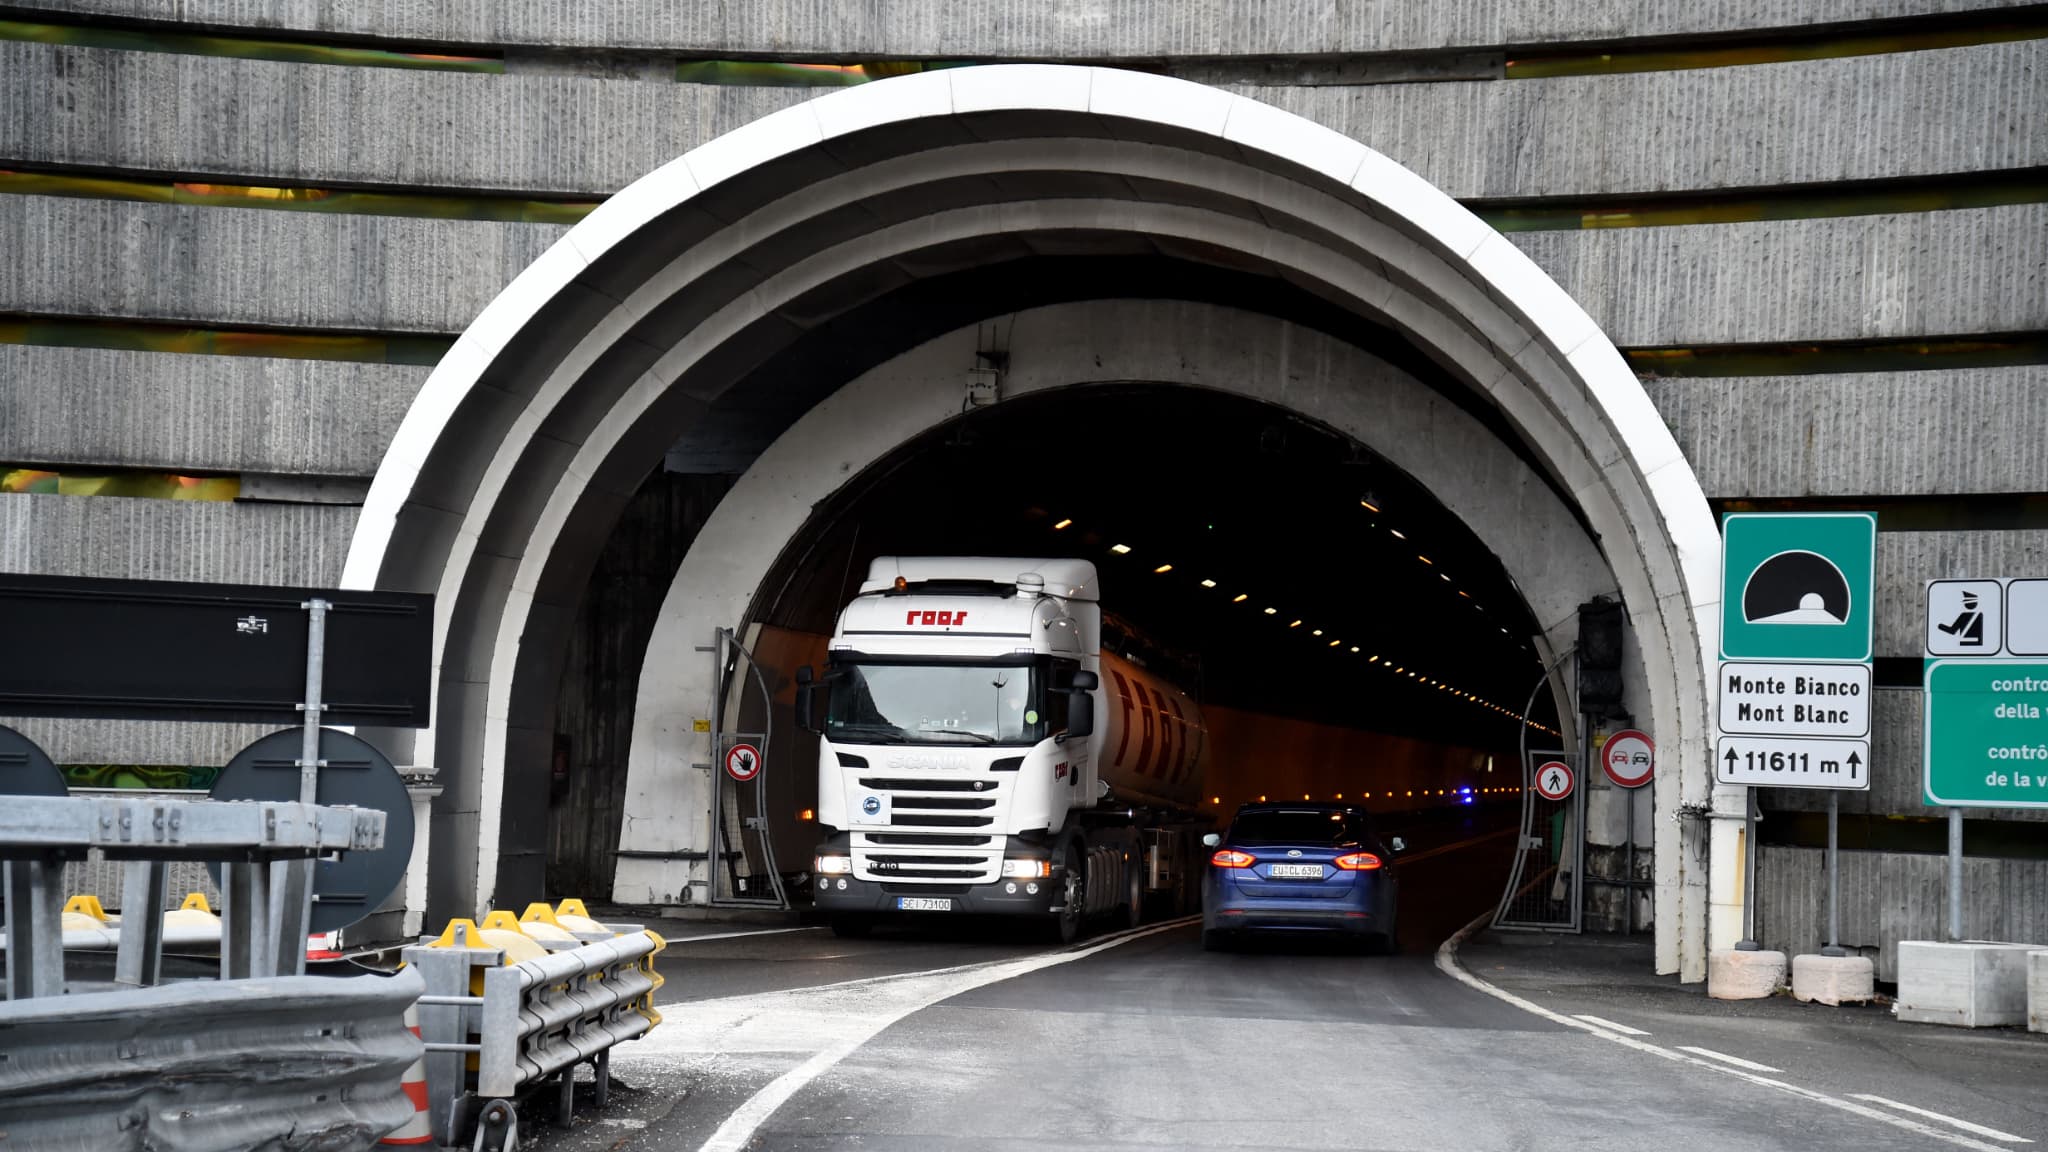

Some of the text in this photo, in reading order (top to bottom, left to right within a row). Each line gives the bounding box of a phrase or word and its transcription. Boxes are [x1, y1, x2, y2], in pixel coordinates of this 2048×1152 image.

[906, 610, 967, 626] roos
[1728, 675, 1861, 697] Monte Bianco
[1991, 676, 2048, 692] contro
[1738, 702, 1850, 724] Mont Blanc
[1994, 703, 2041, 719] della
[1988, 744, 2048, 760] contrô
[886, 753, 971, 770] SCANIA
[1745, 751, 1840, 774] 11611 m
[1985, 770, 2048, 788] de la v
